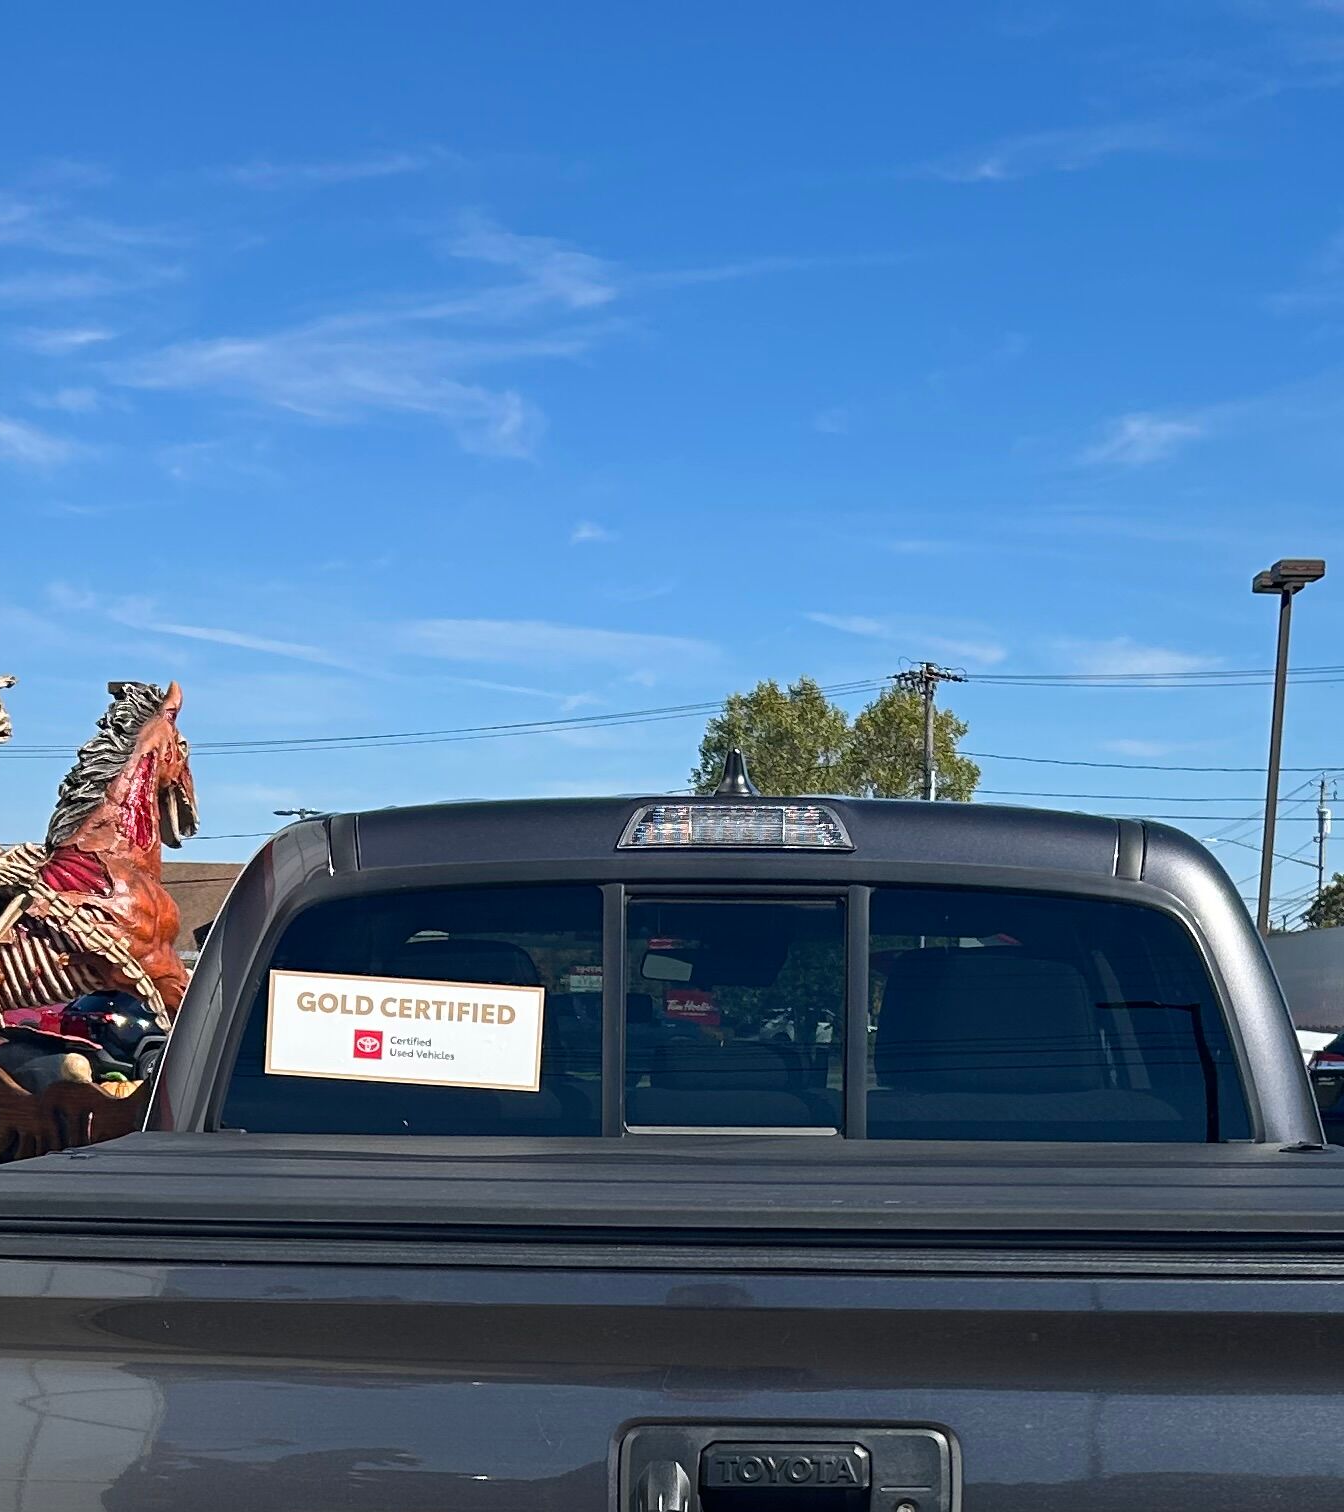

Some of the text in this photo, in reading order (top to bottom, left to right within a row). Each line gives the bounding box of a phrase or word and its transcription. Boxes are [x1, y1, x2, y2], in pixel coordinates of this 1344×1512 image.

[297, 991, 516, 1025] GOLD CERTIFIED
[389, 1036, 432, 1047] Certified
[389, 1048, 455, 1061] Used Vehicles
[715, 1455, 858, 1484] TOYOTA
